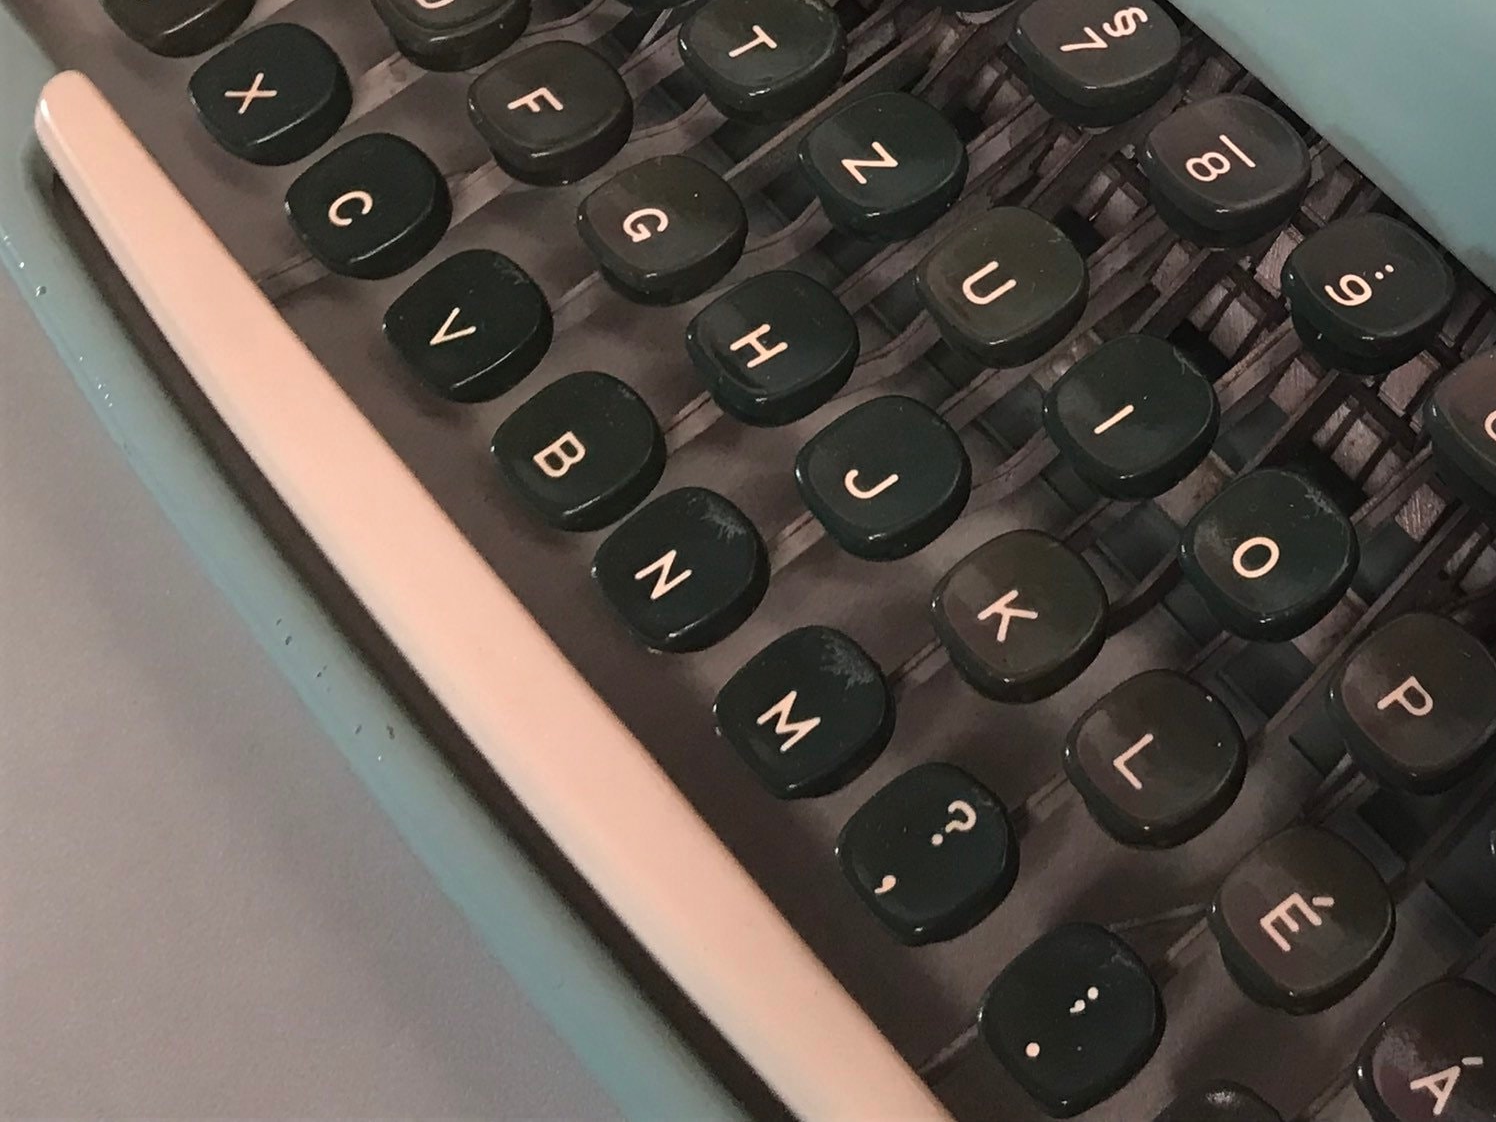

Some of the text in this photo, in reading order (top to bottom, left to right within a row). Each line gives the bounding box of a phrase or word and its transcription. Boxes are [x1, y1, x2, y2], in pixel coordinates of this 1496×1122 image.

[728, 25, 778, 58] T
[1060, 26, 1107, 52] 7
[1102, 7, 1148, 38] §
[224, 72, 278, 114] X
[507, 87, 564, 113] F
[841, 141, 899, 185] Z
[1185, 151, 1231, 182] 8
[328, 190, 373, 226] C
[622, 208, 669, 243] G
[962, 260, 1017, 305] U
[1324, 274, 1373, 306] 9
[429, 307, 477, 345] V
[729, 323, 788, 368] H
[533, 431, 586, 478] B
[844, 469, 899, 499] J
[634, 549, 692, 600] N
[1232, 536, 1280, 579] O
[977, 589, 1038, 642] K
[1377, 676, 1433, 716] P
[757, 690, 821, 752] M
[1113, 733, 1154, 790] L
[931, 800, 977, 846] ?
[1259, 892, 1334, 952] É
[1409, 1057, 1483, 1116] Á
